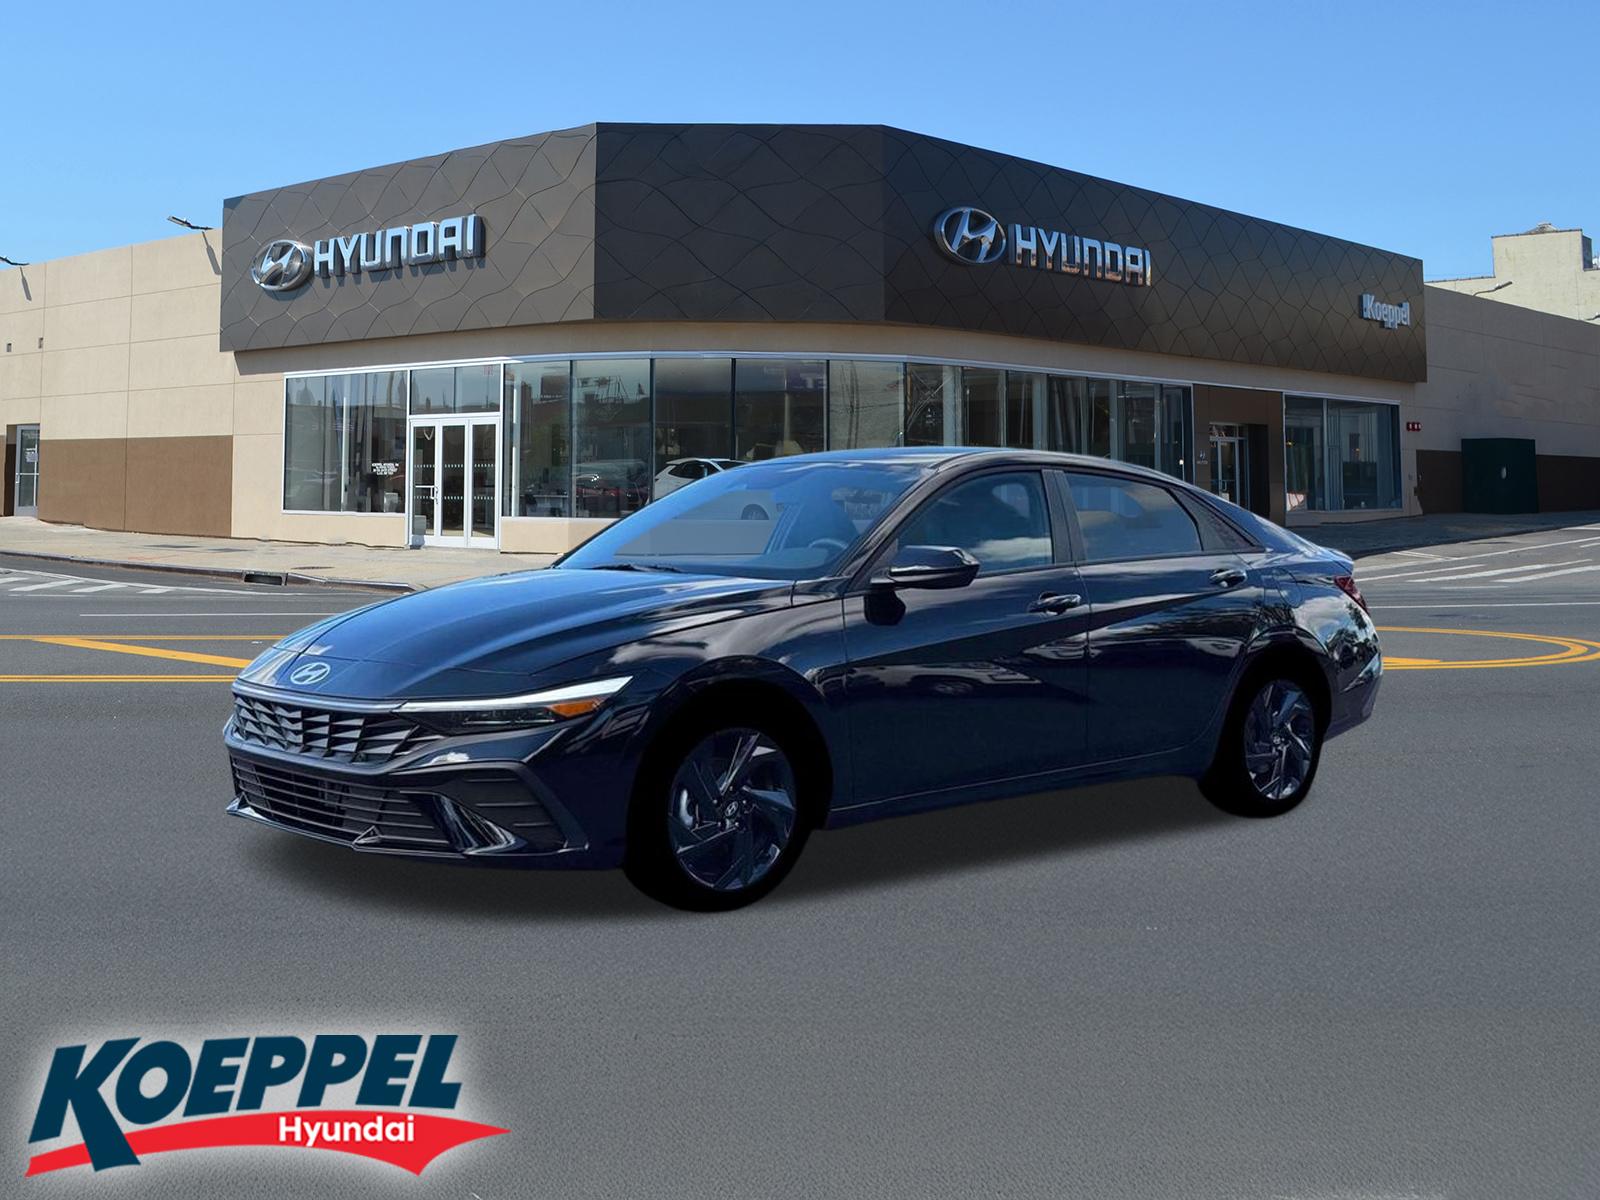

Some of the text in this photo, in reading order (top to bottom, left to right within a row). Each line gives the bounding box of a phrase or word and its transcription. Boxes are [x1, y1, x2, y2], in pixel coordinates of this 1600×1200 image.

[314, 214, 482, 279] HYUNDAI
[1014, 224, 1152, 287] HYUNDAI
[1362, 293, 1410, 329] Koeppel
